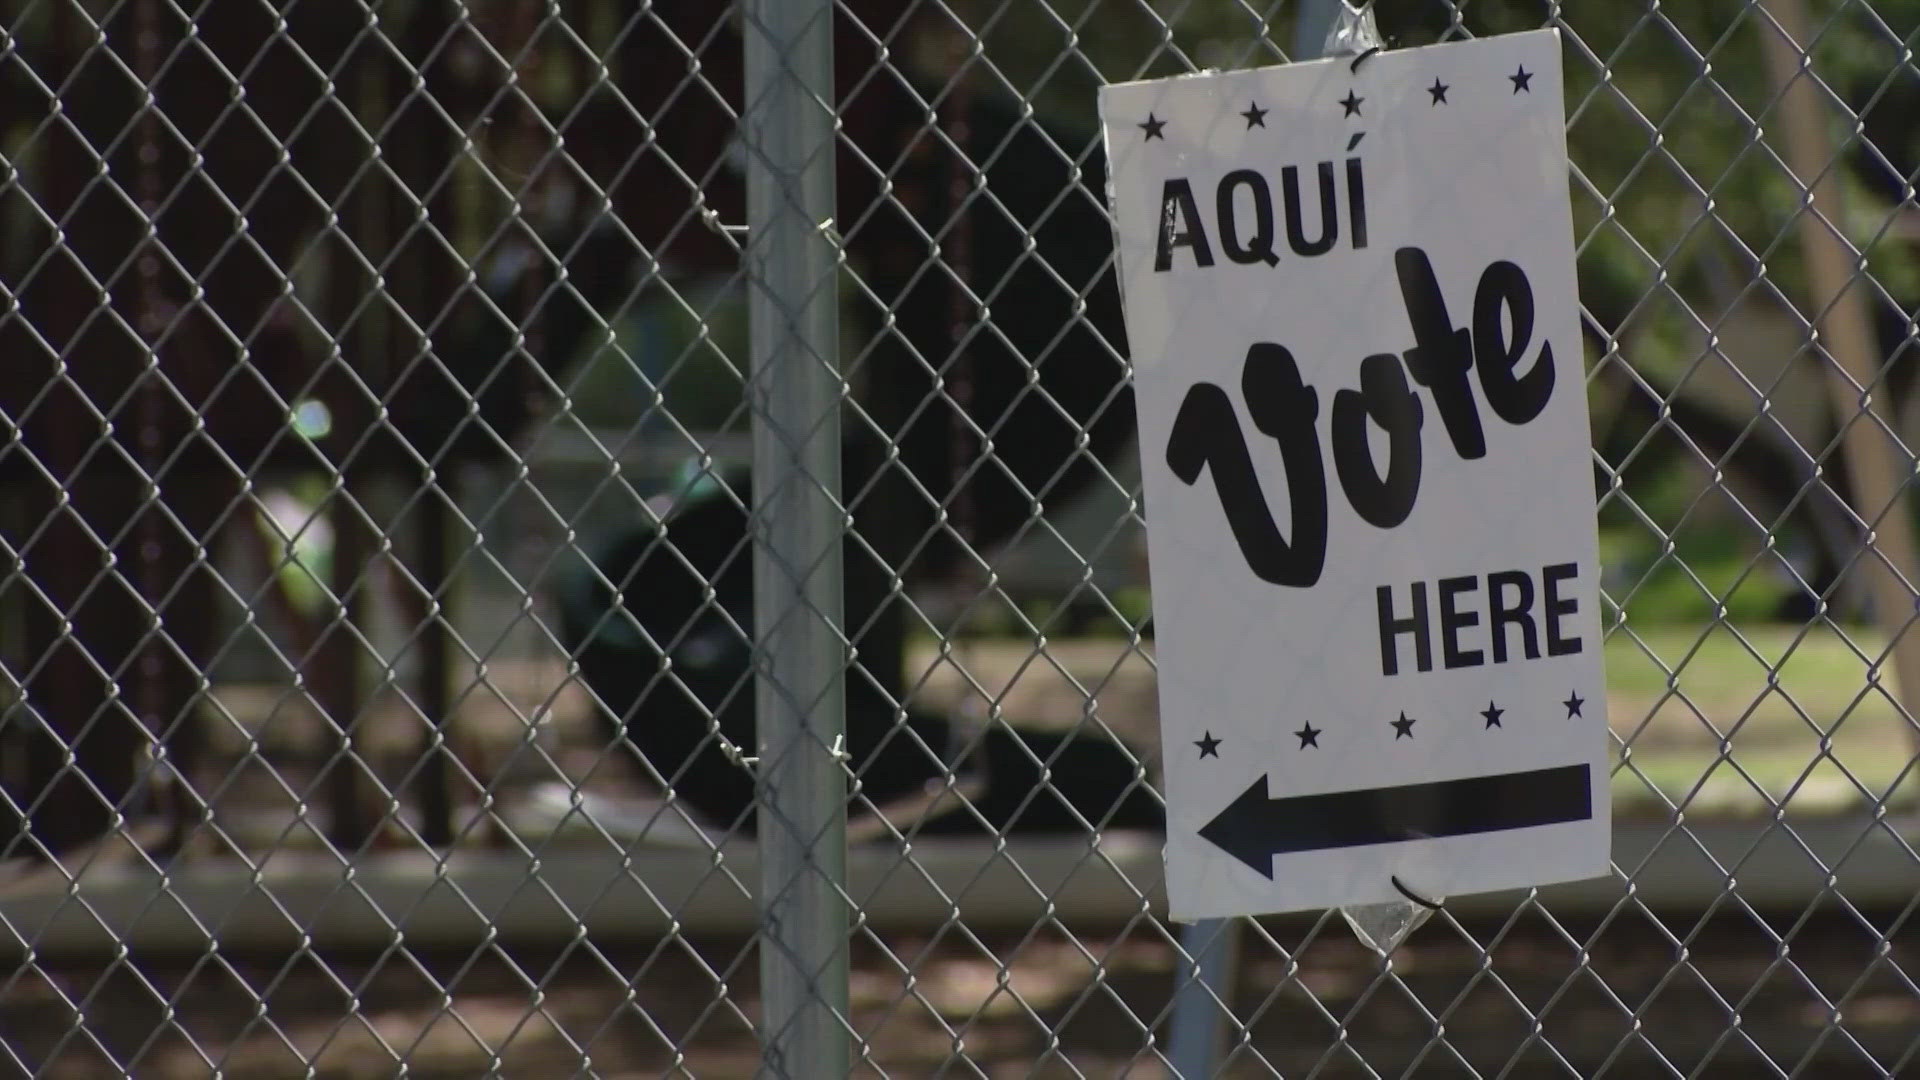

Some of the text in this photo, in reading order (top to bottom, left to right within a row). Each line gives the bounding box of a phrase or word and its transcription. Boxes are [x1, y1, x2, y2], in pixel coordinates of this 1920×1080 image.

[1154, 131, 1368, 272] AQUÍ
[1165, 246, 1556, 588] Vote
[1375, 562, 1583, 677] HERE
